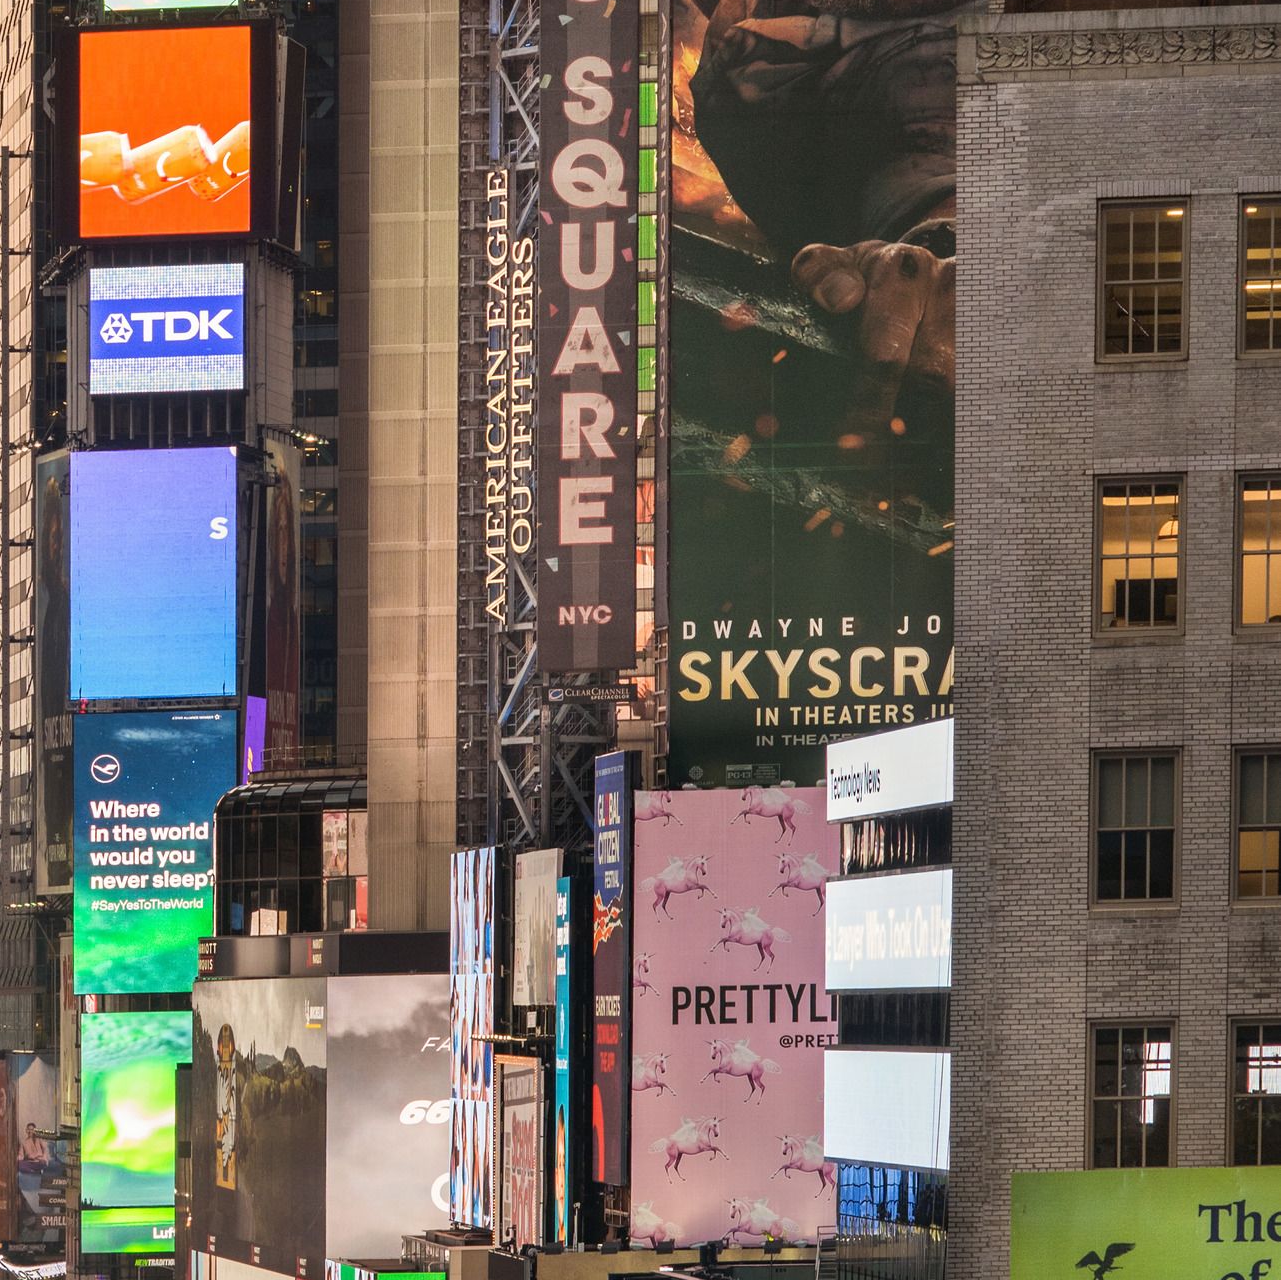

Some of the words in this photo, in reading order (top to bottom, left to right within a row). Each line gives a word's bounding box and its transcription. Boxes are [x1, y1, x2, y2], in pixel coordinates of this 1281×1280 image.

[485, 168, 509, 332] EAGLE
[551, 54, 628, 547] SQUARE
[131, 308, 233, 344] TDK
[510, 236, 535, 555] OUTFITTERS
[484, 348, 509, 626] AMERICAN
[208, 515, 229, 539] S
[558, 603, 613, 626] NYC
[682, 616, 855, 641] DWAYNE
[755, 706, 780, 728] IN
[789, 703, 915, 726] THEATERS
[755, 735, 774, 747] IN
[830, 767, 864, 803] Technology
[863, 761, 881, 793] News
[89, 800, 160, 819] Where
[89, 824, 110, 843] in
[113, 823, 147, 842] the
[151, 822, 209, 841] world
[89, 846, 154, 867] would
[157, 849, 196, 868] you
[89, 873, 149, 890] never
[90, 898, 204, 913] #SayYesToTheWorld
